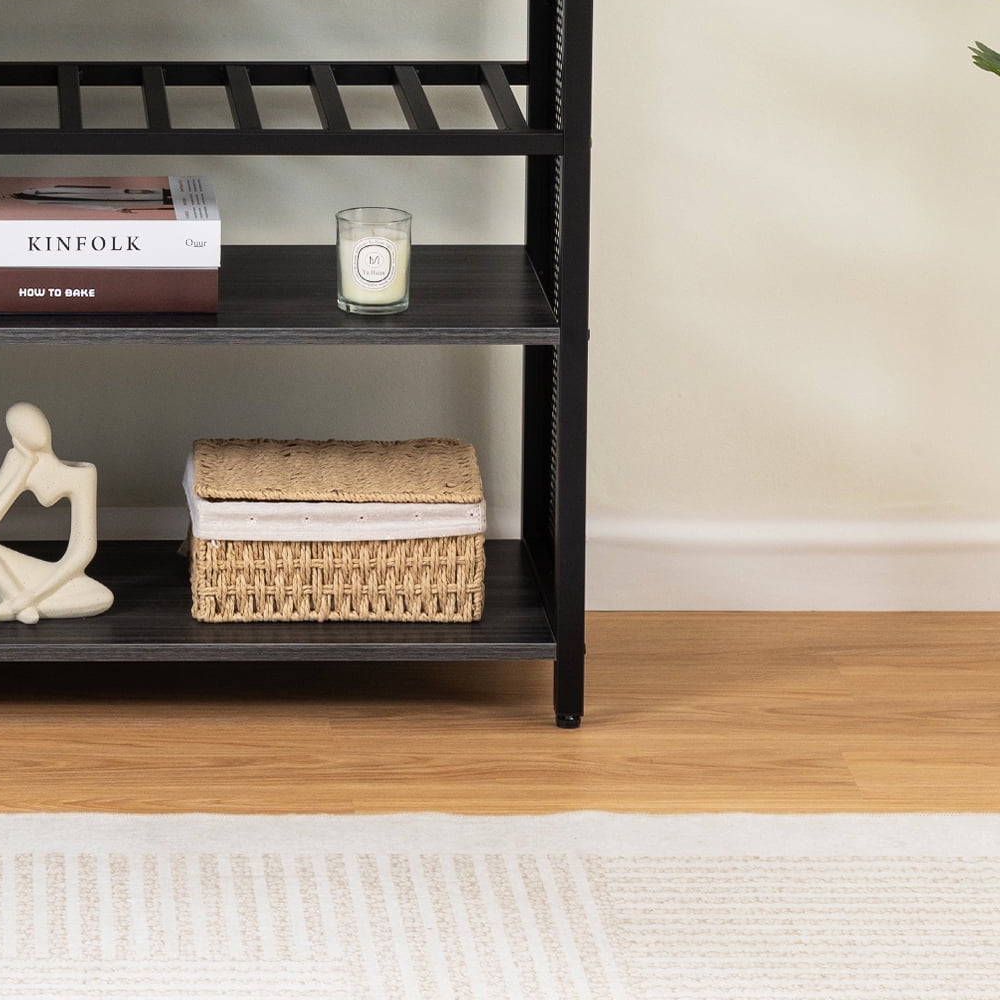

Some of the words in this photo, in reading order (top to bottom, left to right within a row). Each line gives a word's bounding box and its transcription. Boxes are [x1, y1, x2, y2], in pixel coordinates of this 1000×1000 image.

[27, 235, 142, 251] KINFOLK
[18, 288, 46, 297] HOW
[47, 288, 62, 297] TO
[64, 288, 96, 298] BAKE
